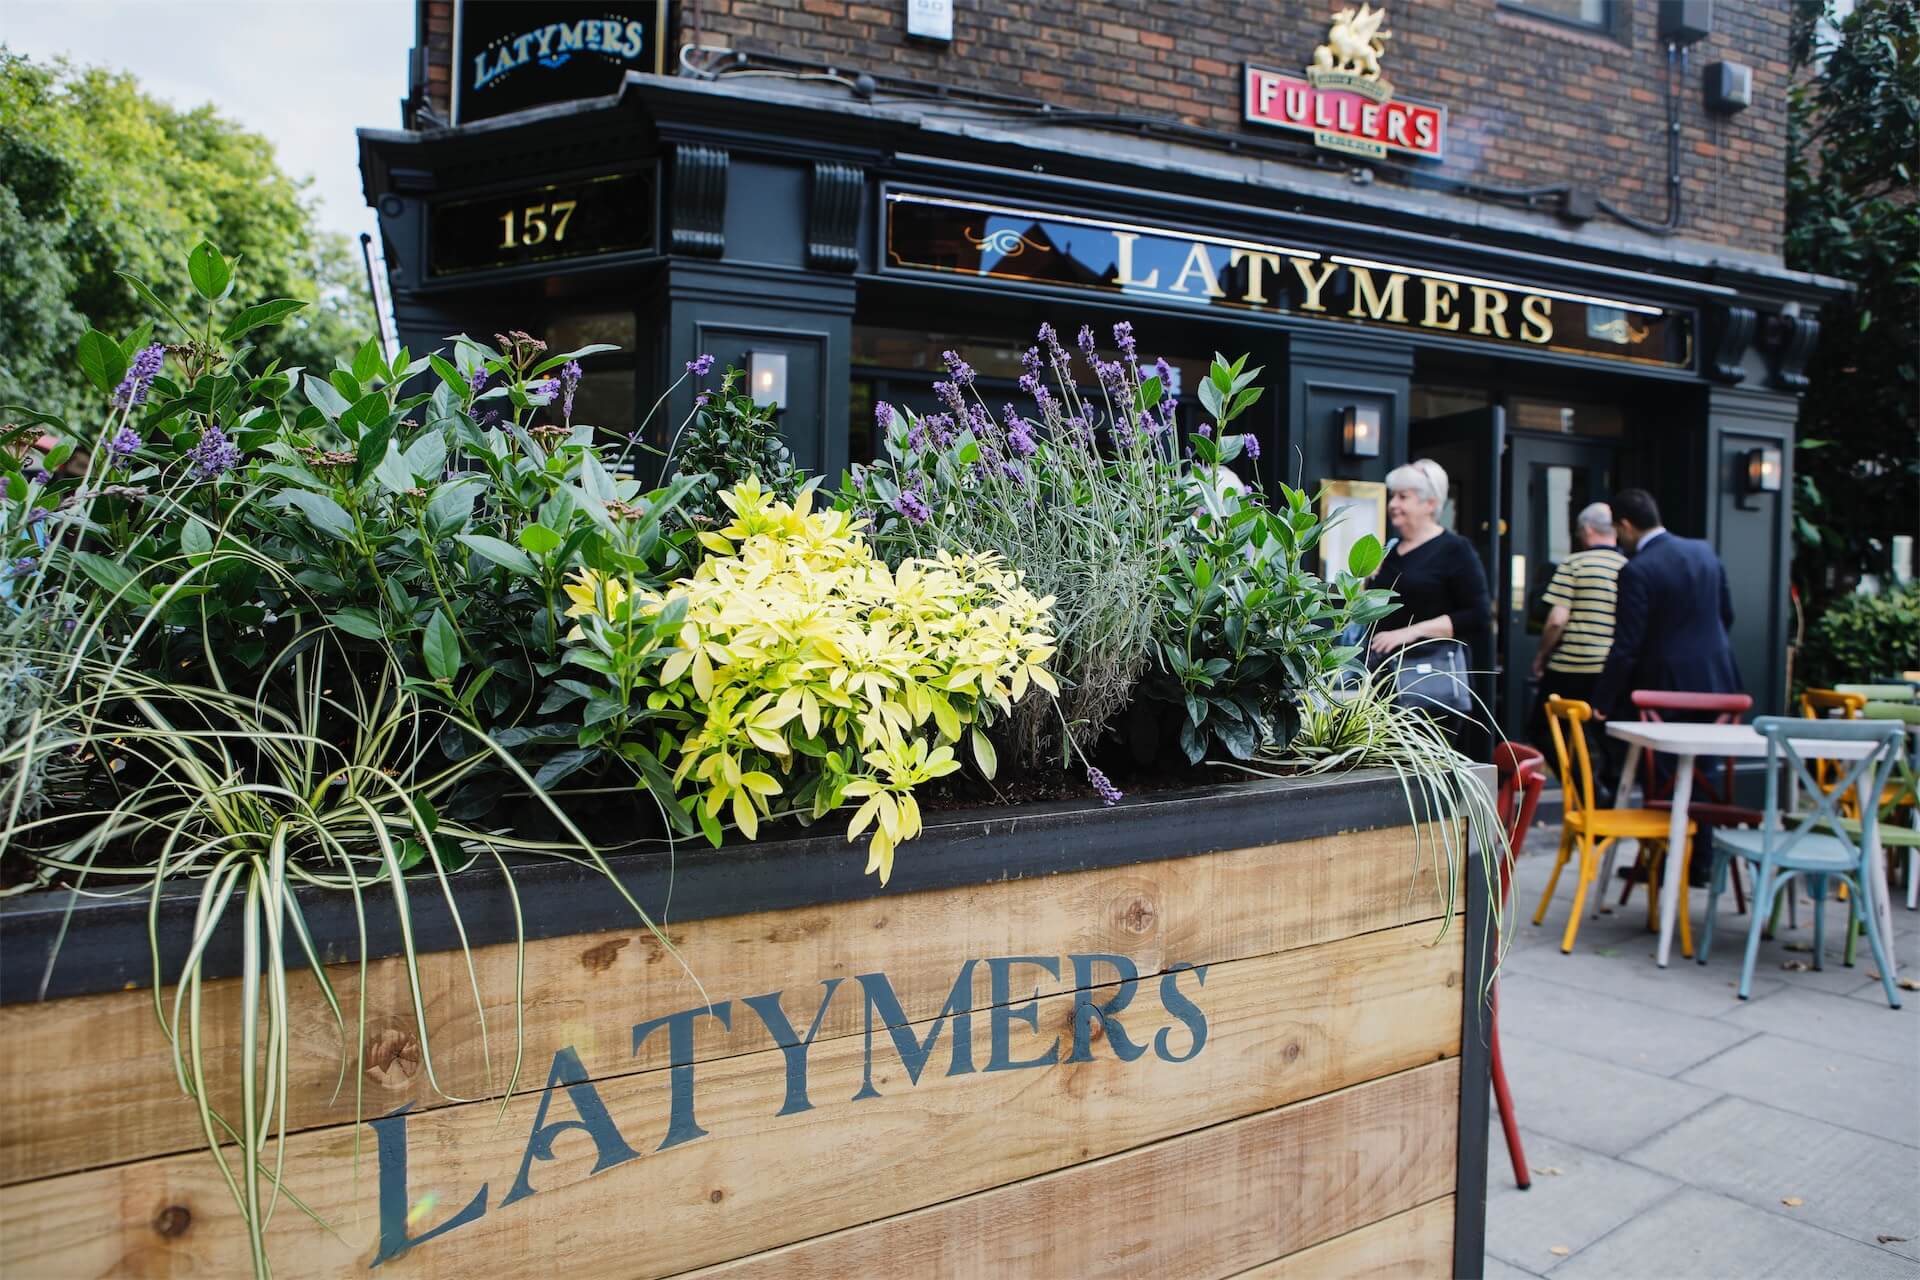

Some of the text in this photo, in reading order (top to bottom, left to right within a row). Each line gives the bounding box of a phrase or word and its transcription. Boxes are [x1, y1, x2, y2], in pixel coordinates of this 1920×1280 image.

[473, 19, 643, 90] LATYMERS
[1258, 76, 1434, 148] FULLER'S
[499, 200, 577, 248] 157
[1112, 231, 1554, 344] LATYMERS
[369, 953, 1208, 1269] LATYMERS
